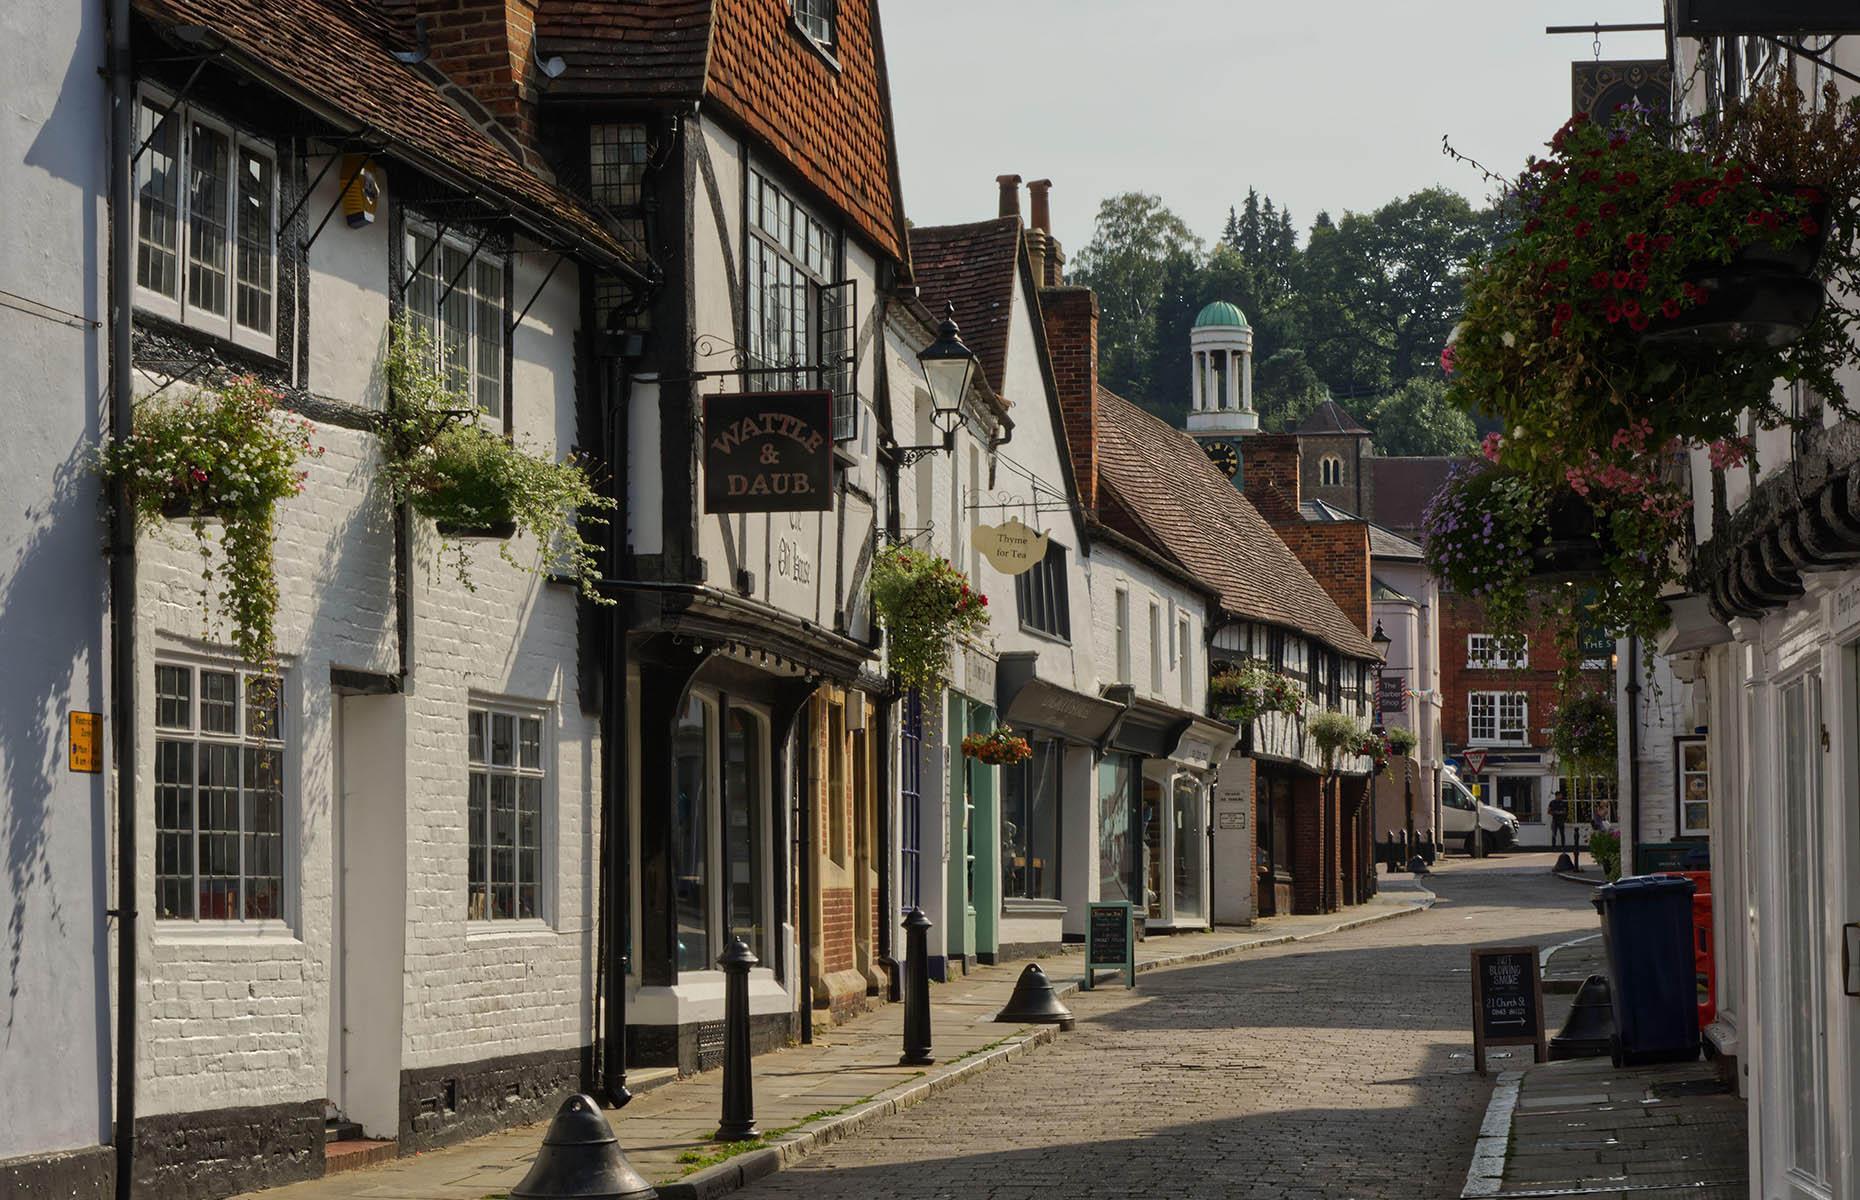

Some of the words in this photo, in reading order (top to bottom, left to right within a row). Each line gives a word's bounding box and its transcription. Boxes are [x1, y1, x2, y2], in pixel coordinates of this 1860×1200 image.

[711, 413, 824, 455] WATTLE
[759, 443, 780, 465] &
[727, 472, 816, 496] DAUB.
[997, 534, 1028, 546] Thyme
[996, 549, 1009, 557] for
[1011, 550, 1027, 559] Tea
[1583, 640, 1604, 649] THE
[1381, 699, 1400, 708] Shop
[1489, 964, 1521, 976] BLOWING
[1486, 998, 1495, 1008] 21
[1496, 997, 1517, 1008] Church
